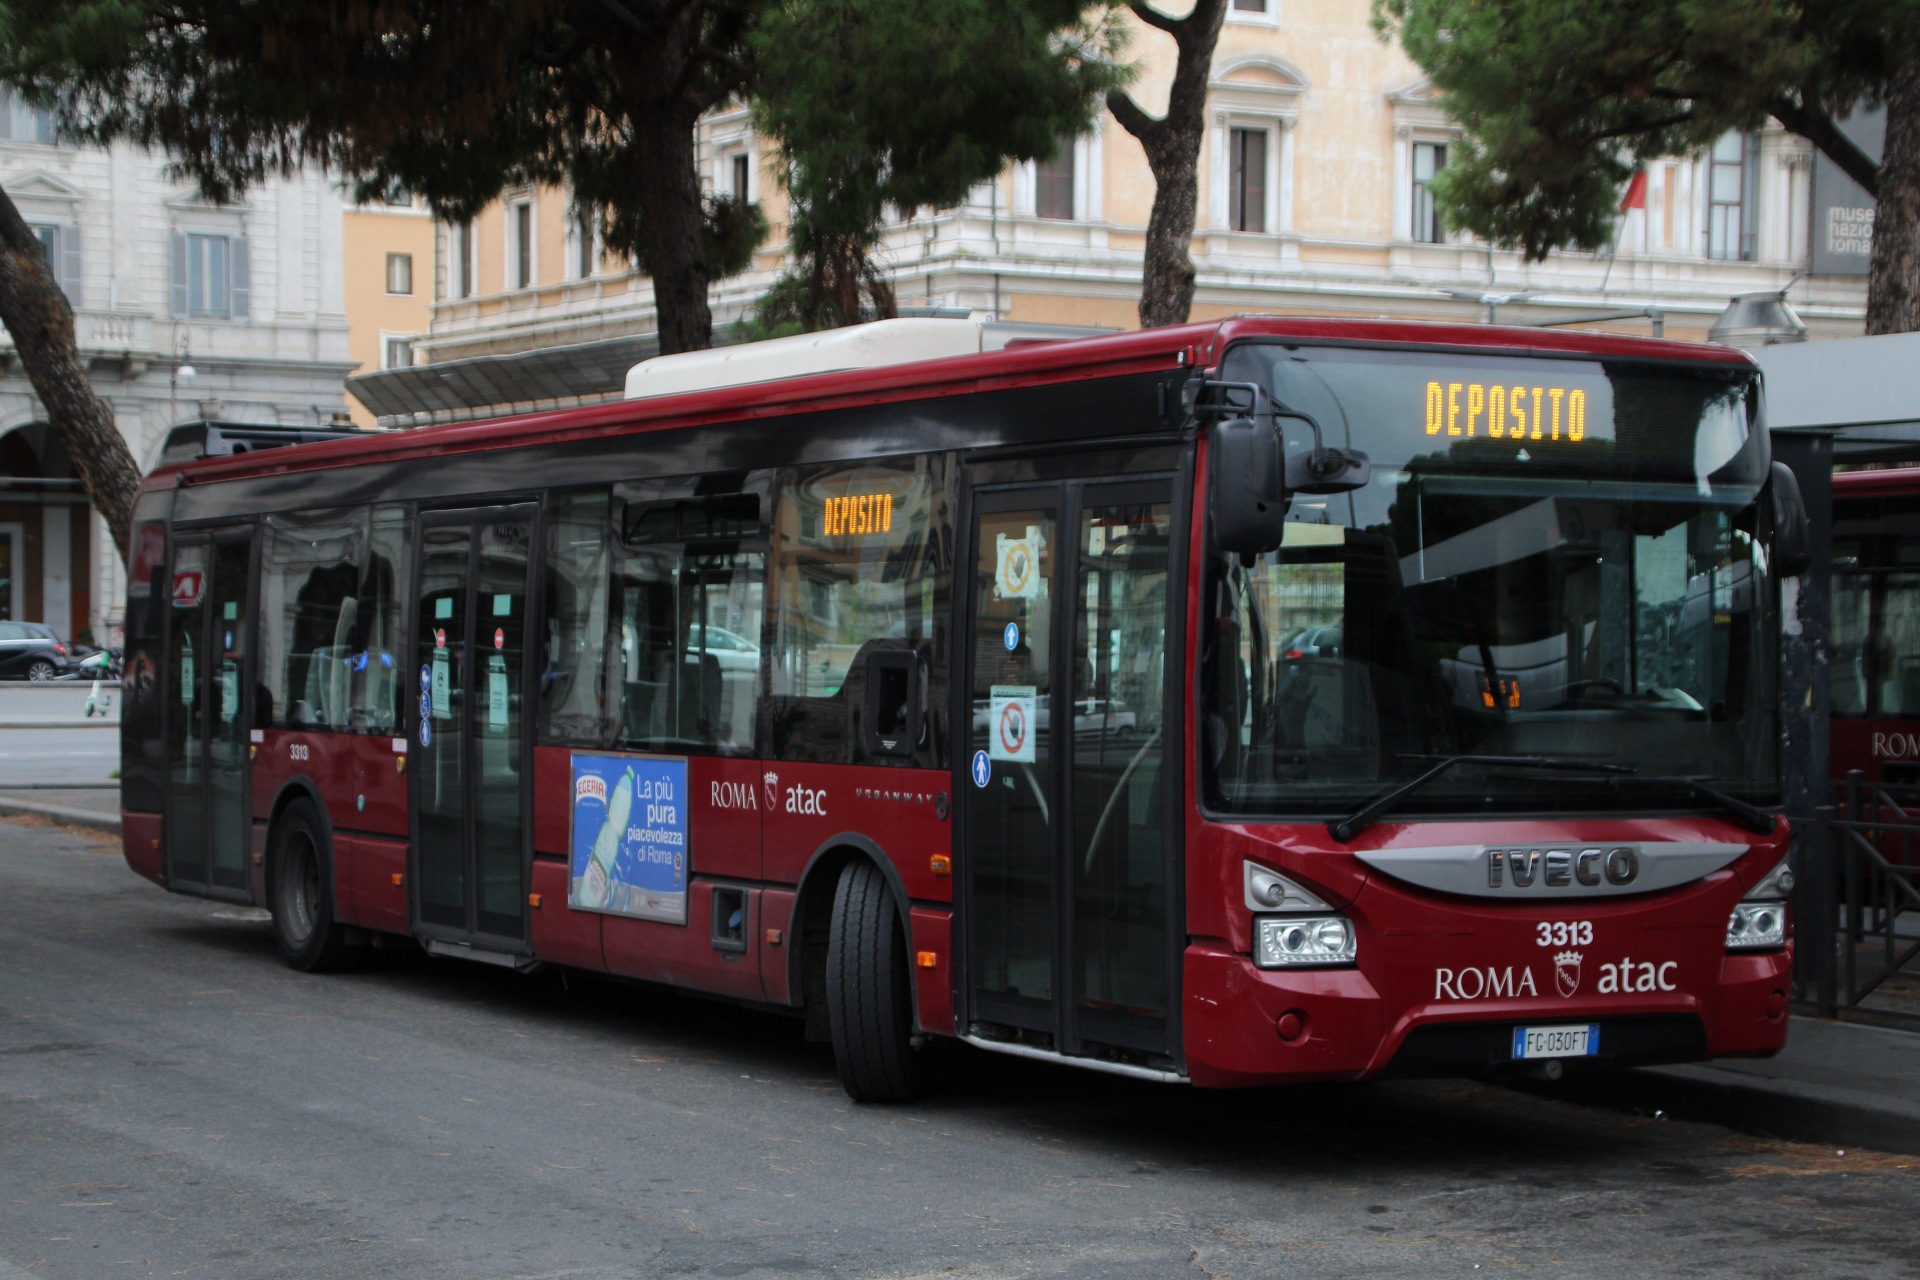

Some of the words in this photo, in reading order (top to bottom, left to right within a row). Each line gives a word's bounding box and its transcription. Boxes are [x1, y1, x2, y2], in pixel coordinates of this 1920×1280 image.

[1425, 381, 1585, 442] DEPOSITO
[824, 493, 892, 536] DEPOSITO
[290, 744, 309, 760] 3313
[636, 774, 652, 799] La
[655, 776, 673, 804] più
[711, 781, 757, 810] ROMA
[785, 783, 827, 816] atac
[856, 787, 933, 804] URBANWAY
[647, 804, 676, 827] pura
[627, 824, 683, 845] piacevolezza
[637, 844, 646, 862] di
[649, 846, 672, 865] Roma
[1488, 847, 1640, 888] IVECO
[1535, 921, 1594, 947] 3313
[1434, 966, 1539, 1000] ROMA
[1597, 956, 1678, 994] atac
